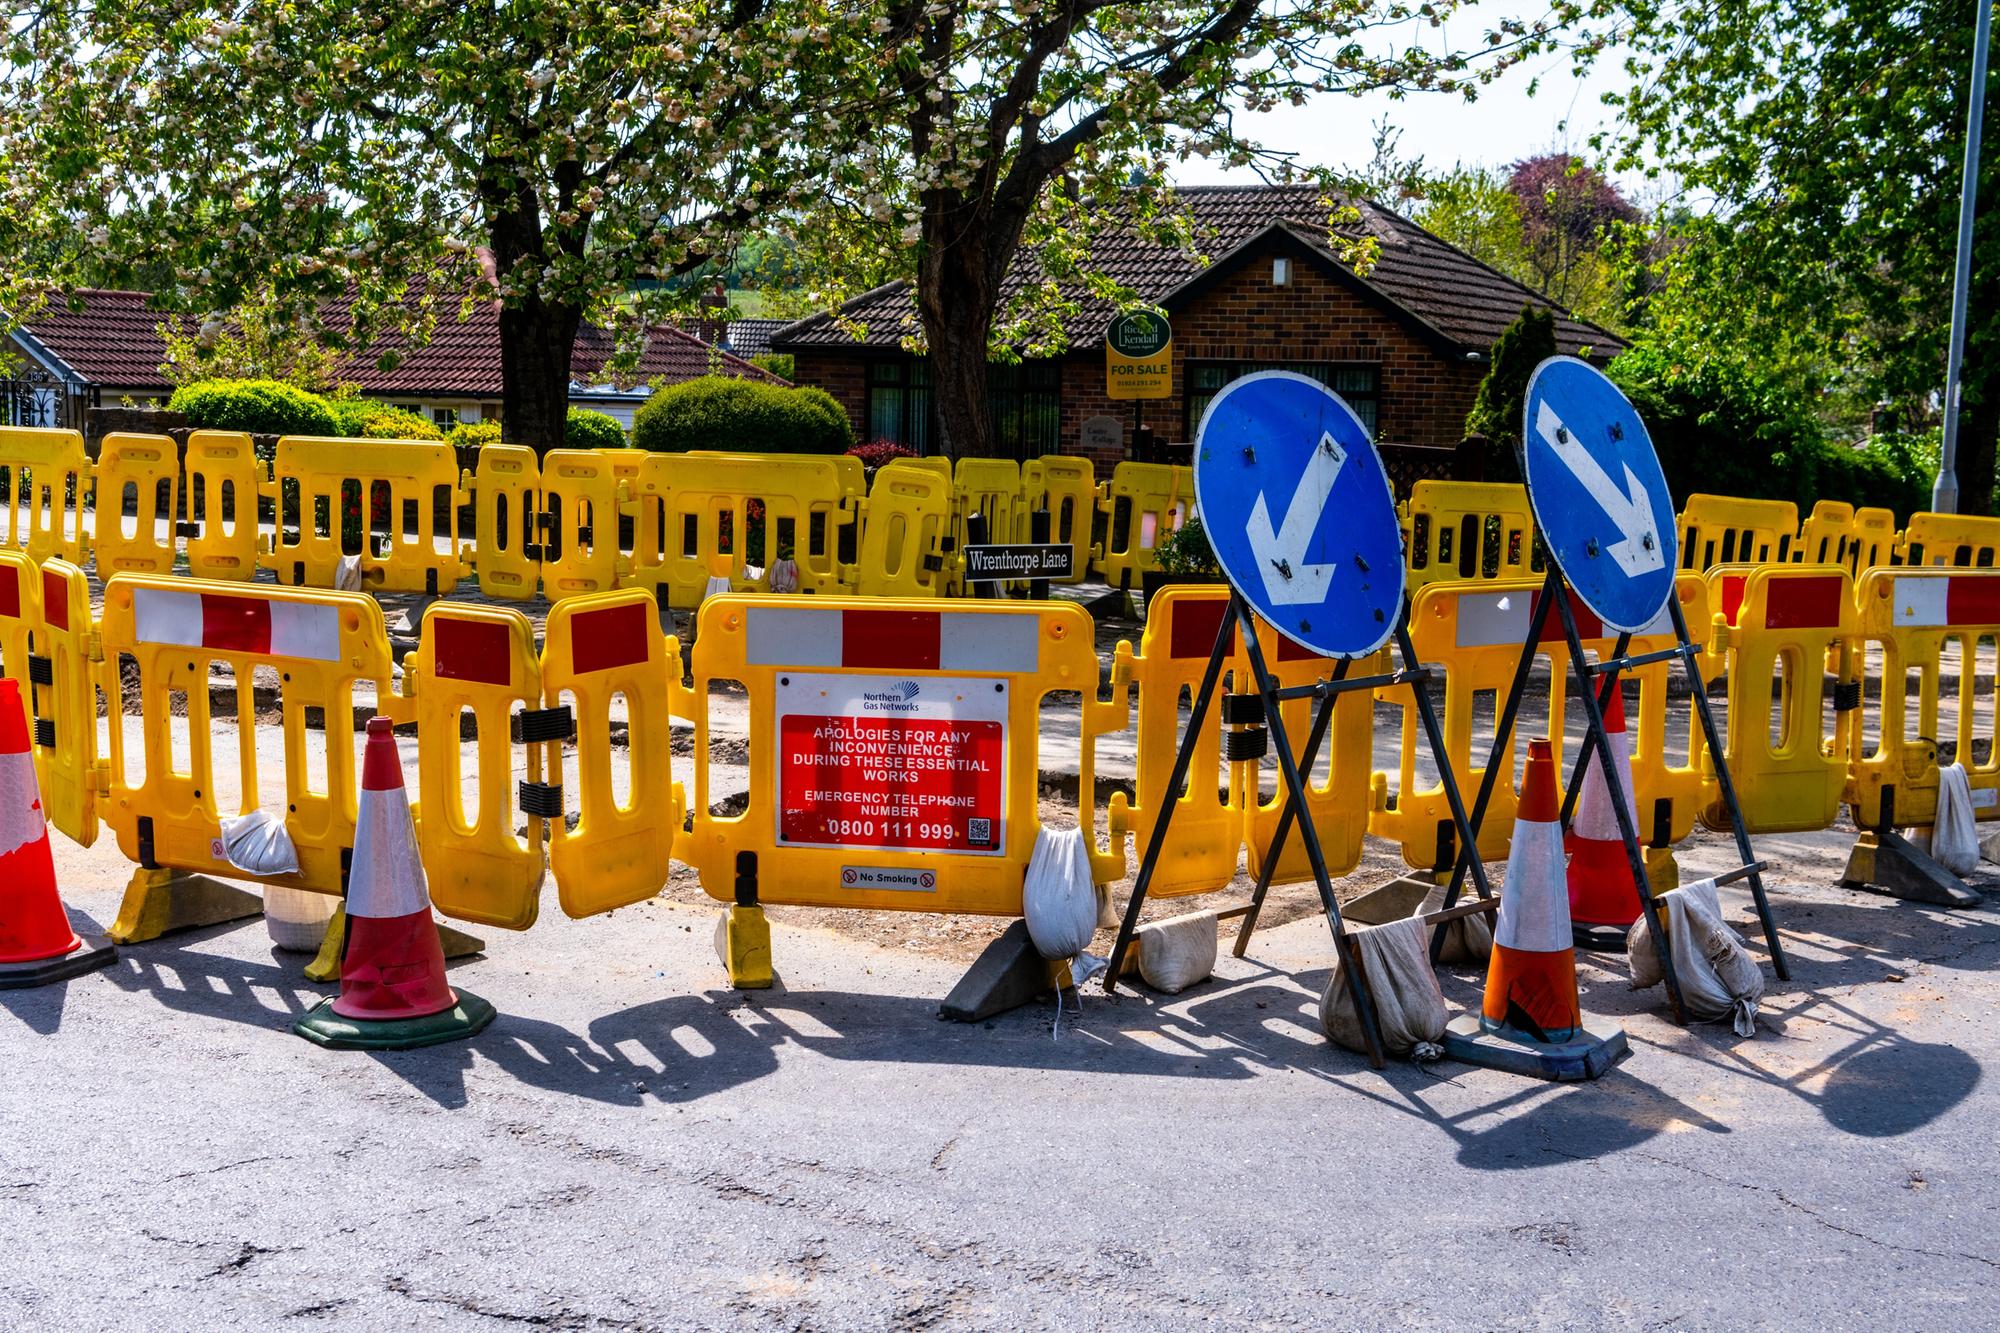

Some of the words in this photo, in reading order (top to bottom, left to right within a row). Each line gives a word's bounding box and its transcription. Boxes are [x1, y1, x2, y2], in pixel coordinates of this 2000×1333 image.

[1124, 324, 1158, 334] Ricd
[1124, 334, 1158, 344] Kendall
[1111, 365, 1134, 375] FOR
[1137, 364, 1168, 375] SALE
[969, 550, 1040, 574] Wrenthorpe
[1041, 549, 1068, 568] Lane
[863, 692, 901, 702] Northern
[863, 702, 879, 710] Gas
[880, 702, 919, 712] Networks
[813, 727, 901, 742] APOLOGIES
[905, 730, 936, 743] FOR
[939, 731, 971, 744] ANY
[829, 741, 954, 757] INCONVENIENCE
[793, 753, 850, 766] DURING
[854, 755, 903, 769] THESE
[906, 758, 990, 772] ESSENTIAL
[863, 770, 919, 782] WORKS
[804, 790, 890, 804] EMERGENCY
[893, 793, 976, 807] TELEPHONE
[861, 805, 919, 817] NUMBER
[828, 819, 874, 836] 0800
[880, 822, 912, 838] 111
[919, 824, 955, 840] 999
[860, 873, 874, 881] No
[876, 873, 918, 885] Smoking
